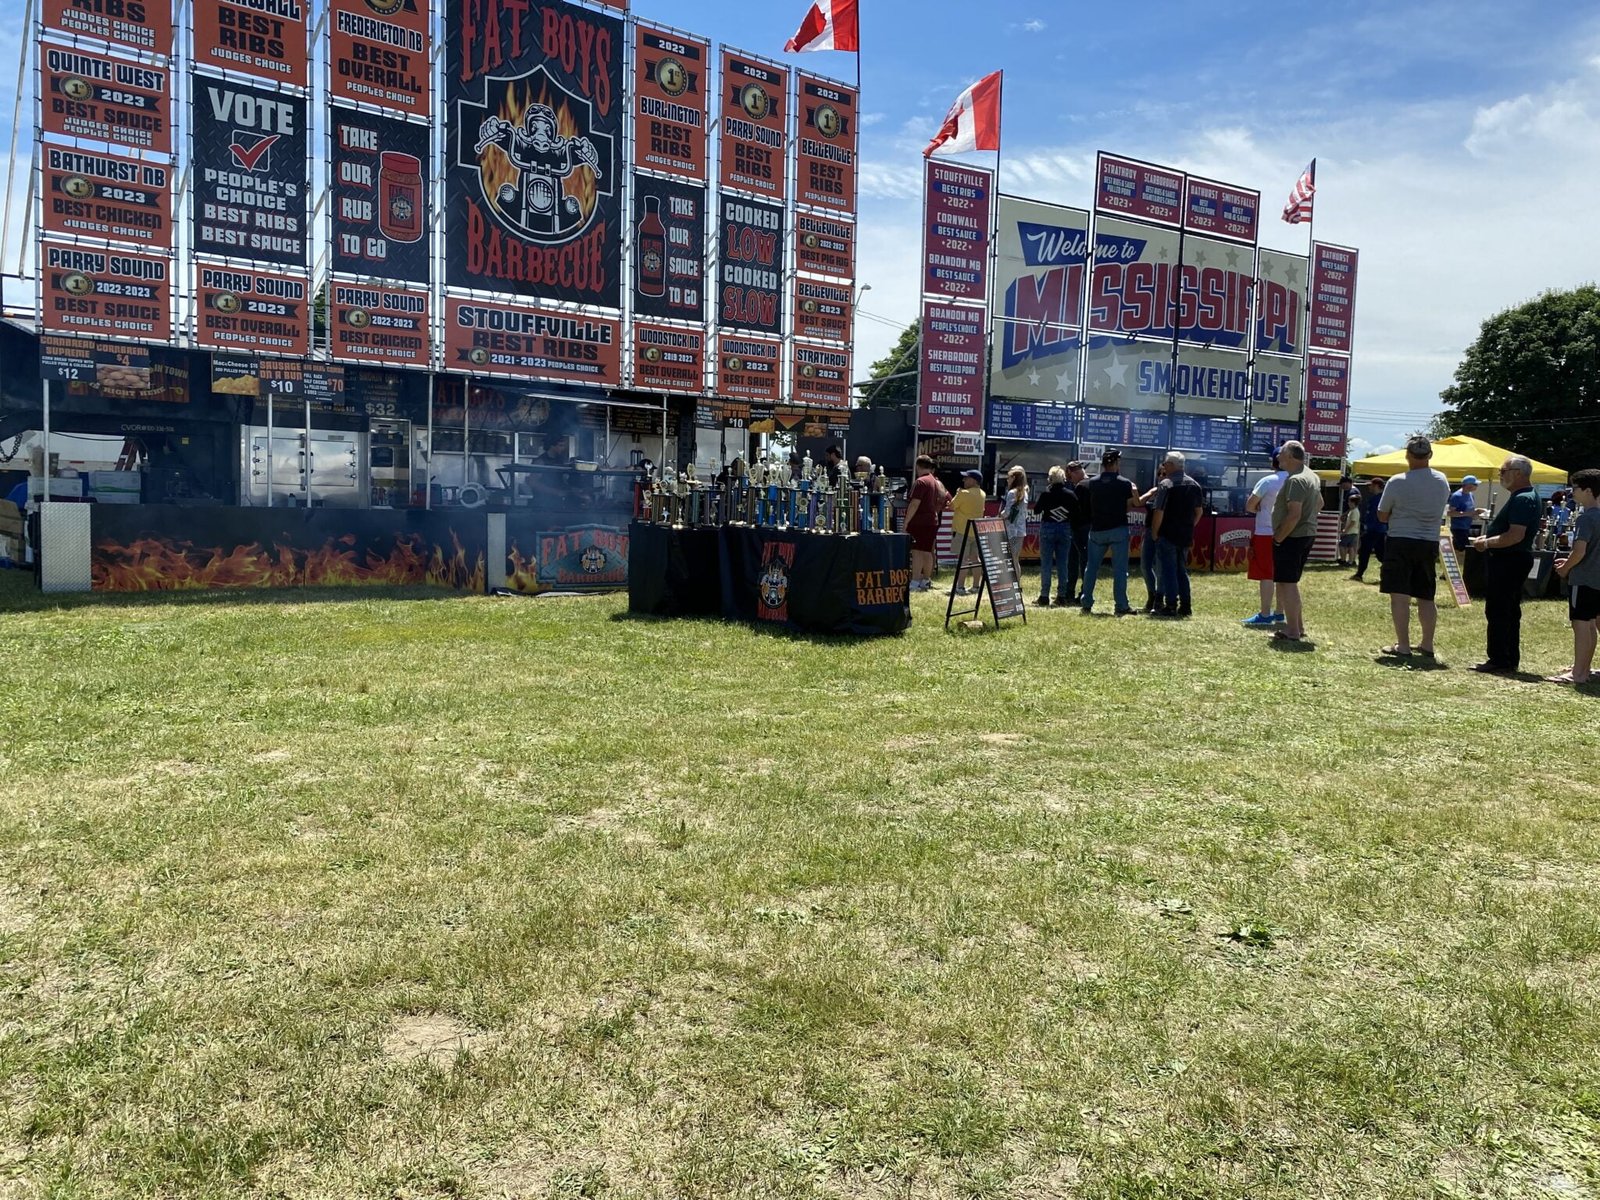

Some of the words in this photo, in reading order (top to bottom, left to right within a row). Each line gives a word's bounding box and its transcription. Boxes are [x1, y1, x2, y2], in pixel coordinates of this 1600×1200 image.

[62, 9, 109, 26] JUDGES
[113, 20, 155, 38] CHOICE
[219, 6, 284, 38] BEST
[337, 9, 407, 49] FREDERICTON
[408, 28, 423, 53] NB
[62, 18, 110, 36] PEOPLES
[113, 30, 155, 47] CHOICE
[220, 27, 284, 58] RIBS
[352, 42, 410, 72] BEST
[658, 40, 685, 54] 2023
[211, 47, 252, 64] JUDGES
[255, 57, 292, 74] CHOICE
[460, 0, 529, 82] FAT
[541, 6, 611, 117] BOYS
[47, 48, 112, 82] QUINTE
[115, 62, 165, 92] WEST
[338, 58, 422, 94] OVERALL
[743, 65, 768, 80] 2023
[101, 89, 145, 107] 2023
[346, 81, 384, 98] PEOPLES
[386, 91, 416, 105] CHOICE
[817, 87, 839, 100] 2023
[52, 98, 98, 120] BEST
[104, 108, 162, 132] SAUCE
[207, 86, 293, 136] VOTE
[640, 95, 701, 128] BURLINGTON
[65, 117, 109, 131] JUDGES
[113, 125, 152, 139] CHOICE
[341, 125, 378, 151] TAKE
[650, 120, 692, 143] BEST
[725, 116, 754, 142] PARRY
[755, 124, 782, 149] SOUND
[651, 137, 691, 158] RIBS
[735, 142, 772, 164] BEST
[801, 137, 852, 166] BELLEVILLE
[48, 148, 139, 183] BATHURST
[141, 165, 166, 188] NB
[341, 162, 371, 187] OUR
[735, 158, 772, 179] RIBS
[810, 161, 843, 180] BEST
[935, 168, 983, 187] STOUFFVILLE
[204, 168, 297, 197] PEOPLE'S
[810, 175, 843, 195] RIBS
[960, 187, 976, 198] RIBS
[102, 187, 145, 203] 2023
[216, 187, 286, 211] CHOICE
[948, 197, 969, 209] 2022
[53, 198, 93, 218] BEST
[95, 204, 162, 229] CHICKEN
[342, 197, 372, 221] RUB
[669, 196, 694, 216] TAKE
[725, 202, 779, 230] COOKED
[204, 203, 249, 224] BEST
[255, 212, 297, 232] RIBS
[936, 212, 978, 229] CORNWALL
[64, 219, 109, 233] JUDGES
[112, 225, 153, 239] CHOICE
[669, 227, 689, 246] OUR
[800, 216, 851, 240] BELLEVILLE
[955, 229, 976, 240] SAUCE
[202, 225, 247, 246] BEST
[251, 233, 300, 254] SAUCE
[342, 233, 360, 255] TO
[366, 237, 386, 258] GO
[465, 196, 606, 293] BARBECUE
[727, 223, 777, 266] LOW
[946, 239, 967, 250] 2022
[1026, 230, 1118, 263] Welcme
[1121, 240, 1137, 259] to
[48, 247, 106, 274] PARRY
[109, 255, 165, 281] SOUND
[669, 257, 698, 276] SAUCE
[929, 253, 966, 268] BRANDON
[969, 260, 981, 271] MB
[201, 268, 253, 294] PARRY
[255, 276, 304, 300] SOUND
[724, 265, 777, 290] COOKED
[945, 281, 965, 293] 2022
[97, 282, 150, 298] 2022-2023
[336, 286, 380, 310] PARRY
[382, 292, 425, 314] SOUND
[669, 286, 680, 303] TO
[684, 289, 697, 305] GO
[799, 282, 850, 303] BELLEVILLE
[54, 297, 98, 314] BEST
[104, 302, 160, 321] SAUCE
[248, 301, 286, 315] 2023
[723, 285, 778, 326] SLOW
[820, 305, 840, 314] 2023
[930, 307, 966, 321] BRANDON
[968, 311, 979, 322] MB
[1008, 262, 1300, 358] MISSISSIPPI
[62, 315, 111, 327] PEOPLES
[114, 319, 153, 331] CHOICE
[205, 314, 239, 331] BEST
[241, 319, 300, 337] OVERALL
[372, 316, 413, 329] 2022-2023
[457, 304, 612, 346] STOUFFVILLE
[931, 321, 957, 332] PEOPLE'S
[214, 331, 256, 343] PEOPLES
[259, 336, 293, 347] CHOICE
[340, 330, 370, 345] BEST
[372, 333, 422, 349] CHICKEN
[472, 330, 536, 353] BEST
[543, 338, 598, 361] RIBS
[639, 328, 688, 348] WOODSTOCK
[722, 339, 766, 357] WOODSTOCK
[943, 334, 964, 344] 2022
[46, 346, 90, 359] SUPREME
[116, 354, 130, 367] $4
[346, 345, 384, 356] PEOPLES
[797, 348, 848, 368] STRATHROY
[928, 349, 979, 363] SHERBROOKE
[58, 367, 79, 379] $12
[164, 365, 189, 378] TOWN
[260, 360, 301, 371] SAUSAGE
[661, 366, 698, 380] OVERALL
[746, 362, 768, 371] 2023
[818, 370, 838, 379] 2023
[270, 380, 293, 393] $10
[327, 378, 344, 392] $70
[747, 375, 775, 388] SAUCE
[942, 375, 962, 386] 2019
[1138, 359, 1290, 405] SMOKEHOUSE
[931, 391, 971, 404] BATHURST
[365, 402, 396, 416] $32
[729, 417, 743, 428] $10
[941, 417, 961, 426] 2018
[541, 531, 585, 566] FAT
[593, 529, 629, 560] BOY
[856, 570, 884, 589] FAT
